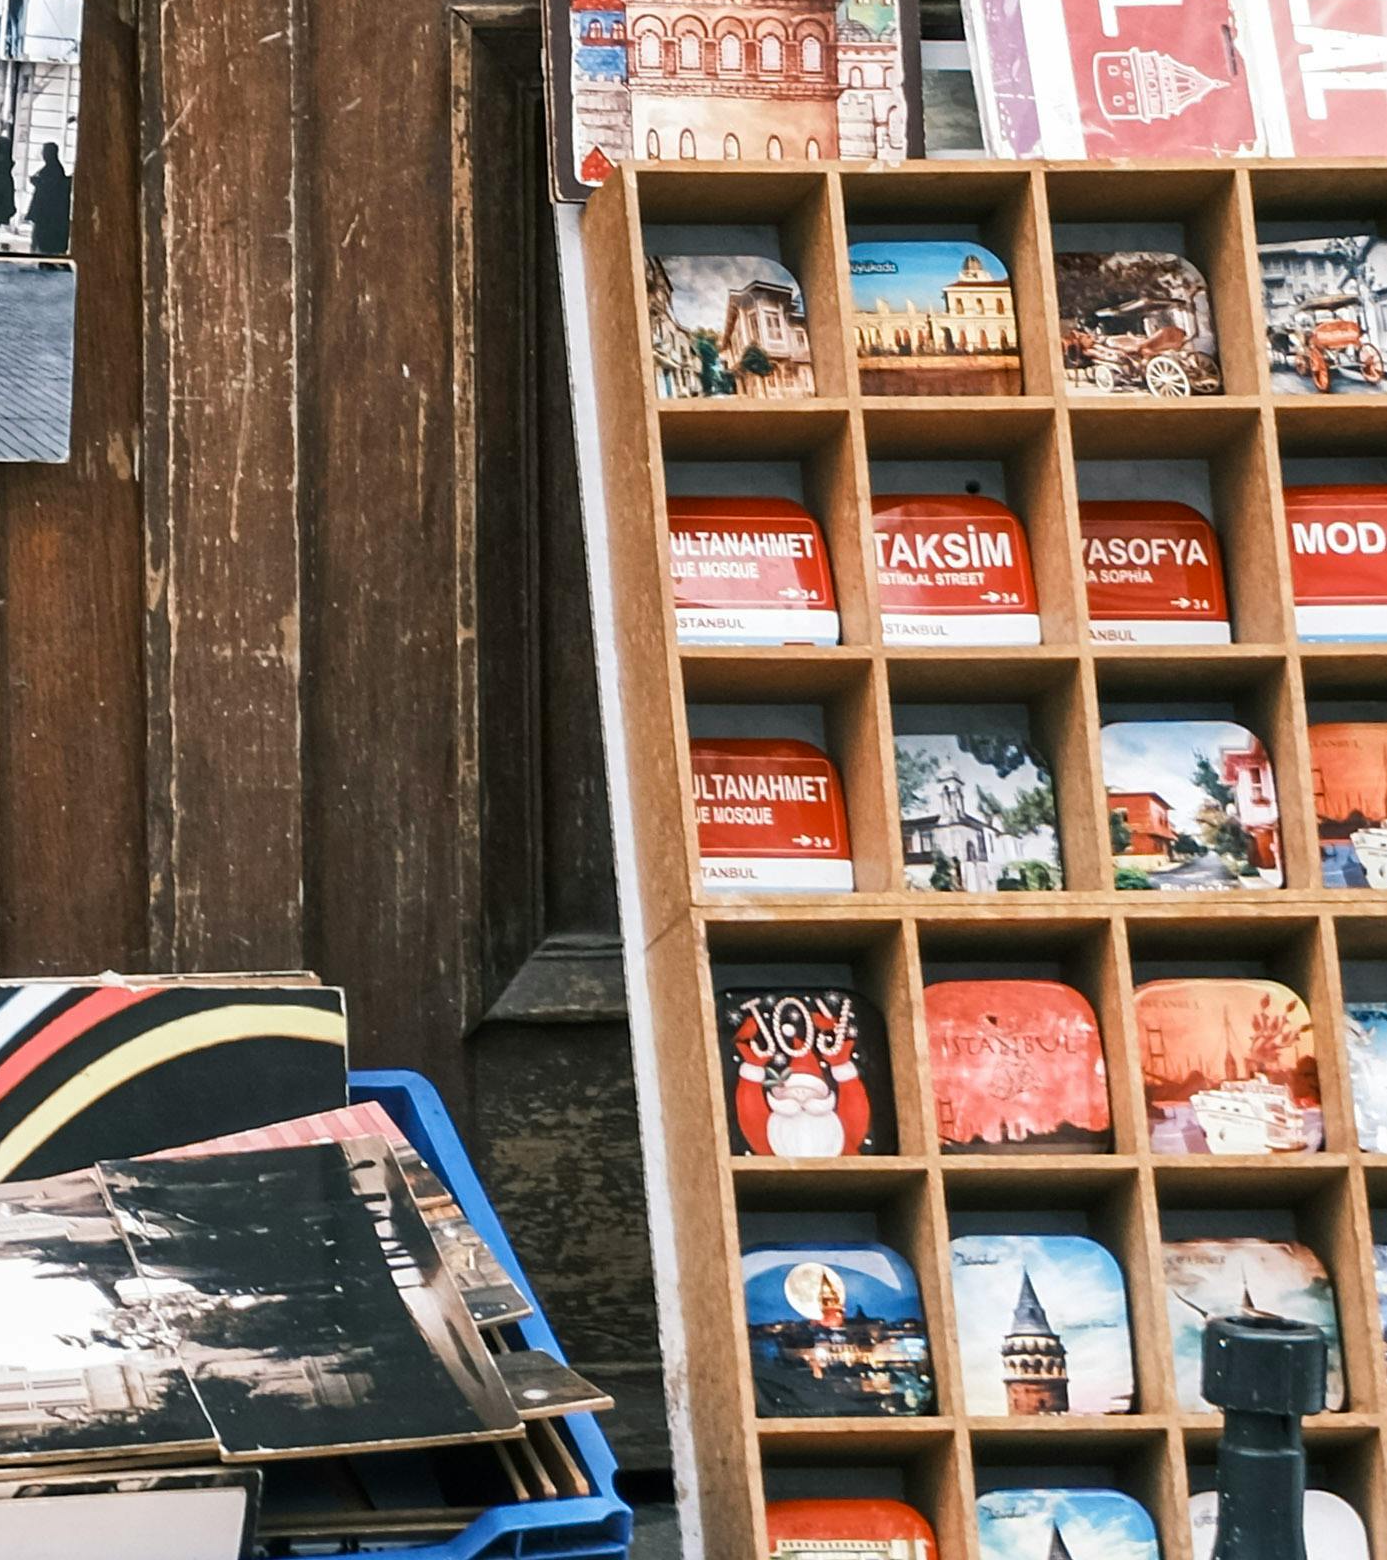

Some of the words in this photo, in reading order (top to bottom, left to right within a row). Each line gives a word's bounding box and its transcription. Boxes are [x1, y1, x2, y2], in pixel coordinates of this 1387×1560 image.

[670, 531, 814, 559] ULTANAHMET
[875, 524, 1013, 569] TAKSİM
[671, 562, 696, 579] LUE
[698, 562, 759, 580] MOSQUE
[935, 572, 984, 586] STREET
[714, 807, 773, 825] MOSQUE
